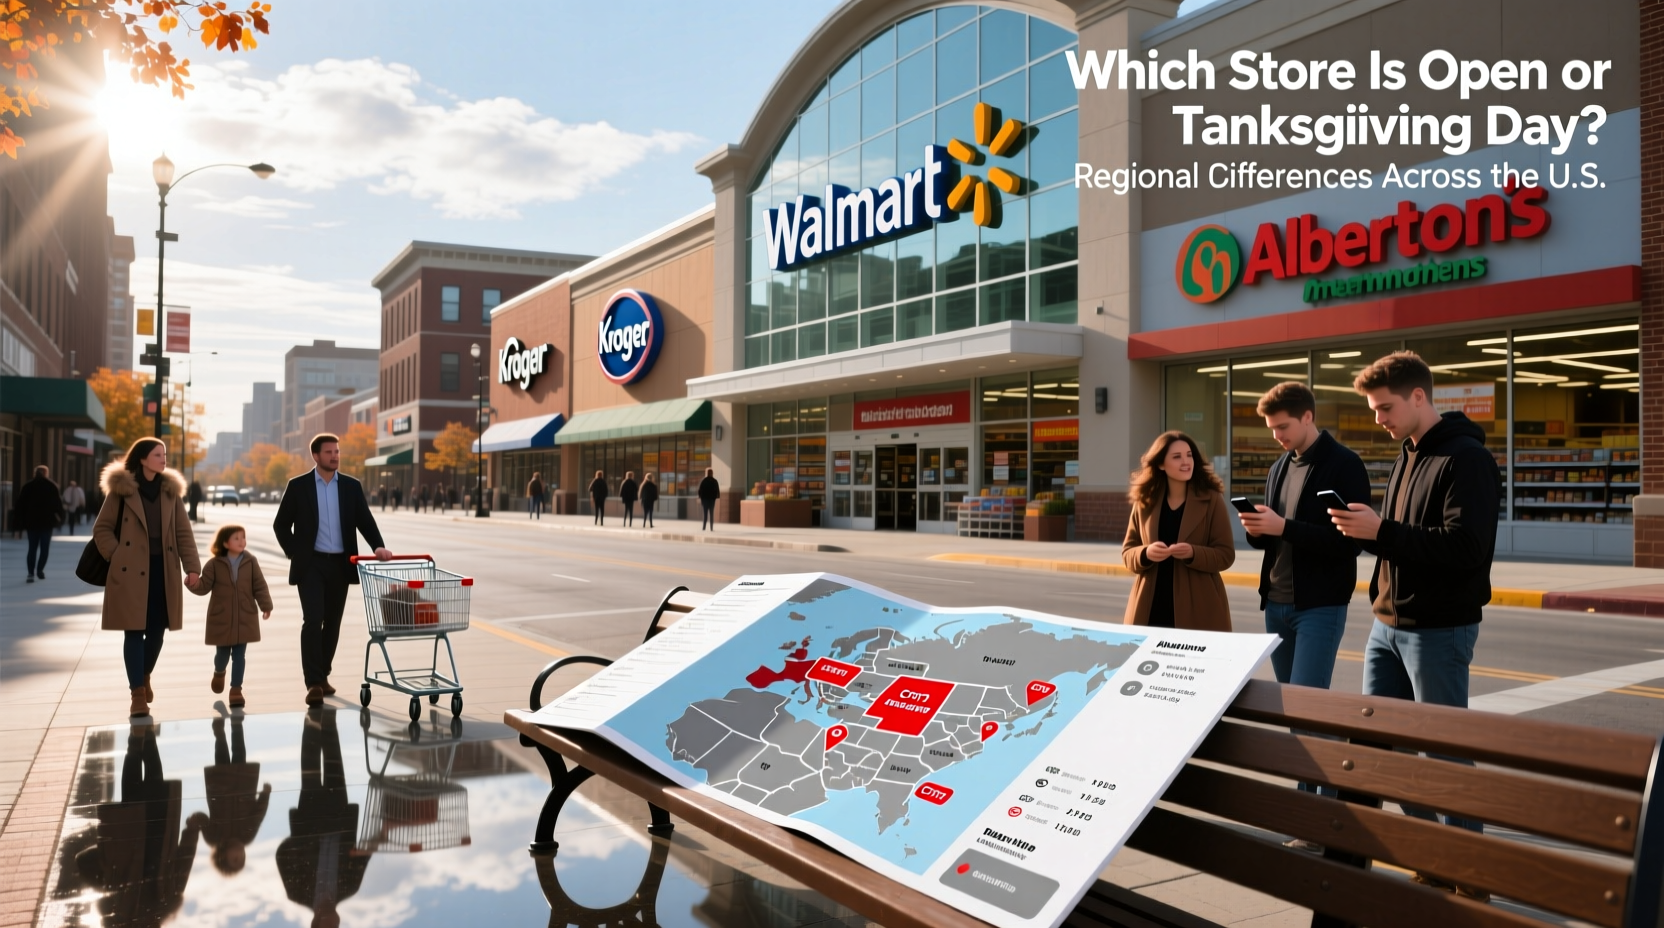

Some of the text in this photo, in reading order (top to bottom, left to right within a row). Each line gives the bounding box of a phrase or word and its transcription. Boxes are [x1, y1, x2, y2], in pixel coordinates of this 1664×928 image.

[763, 144, 950, 272] Walmart
[1243, 177, 1550, 286] Alberton's
[498, 336, 551, 391] Kroger
[597, 315, 651, 362] Kroger
